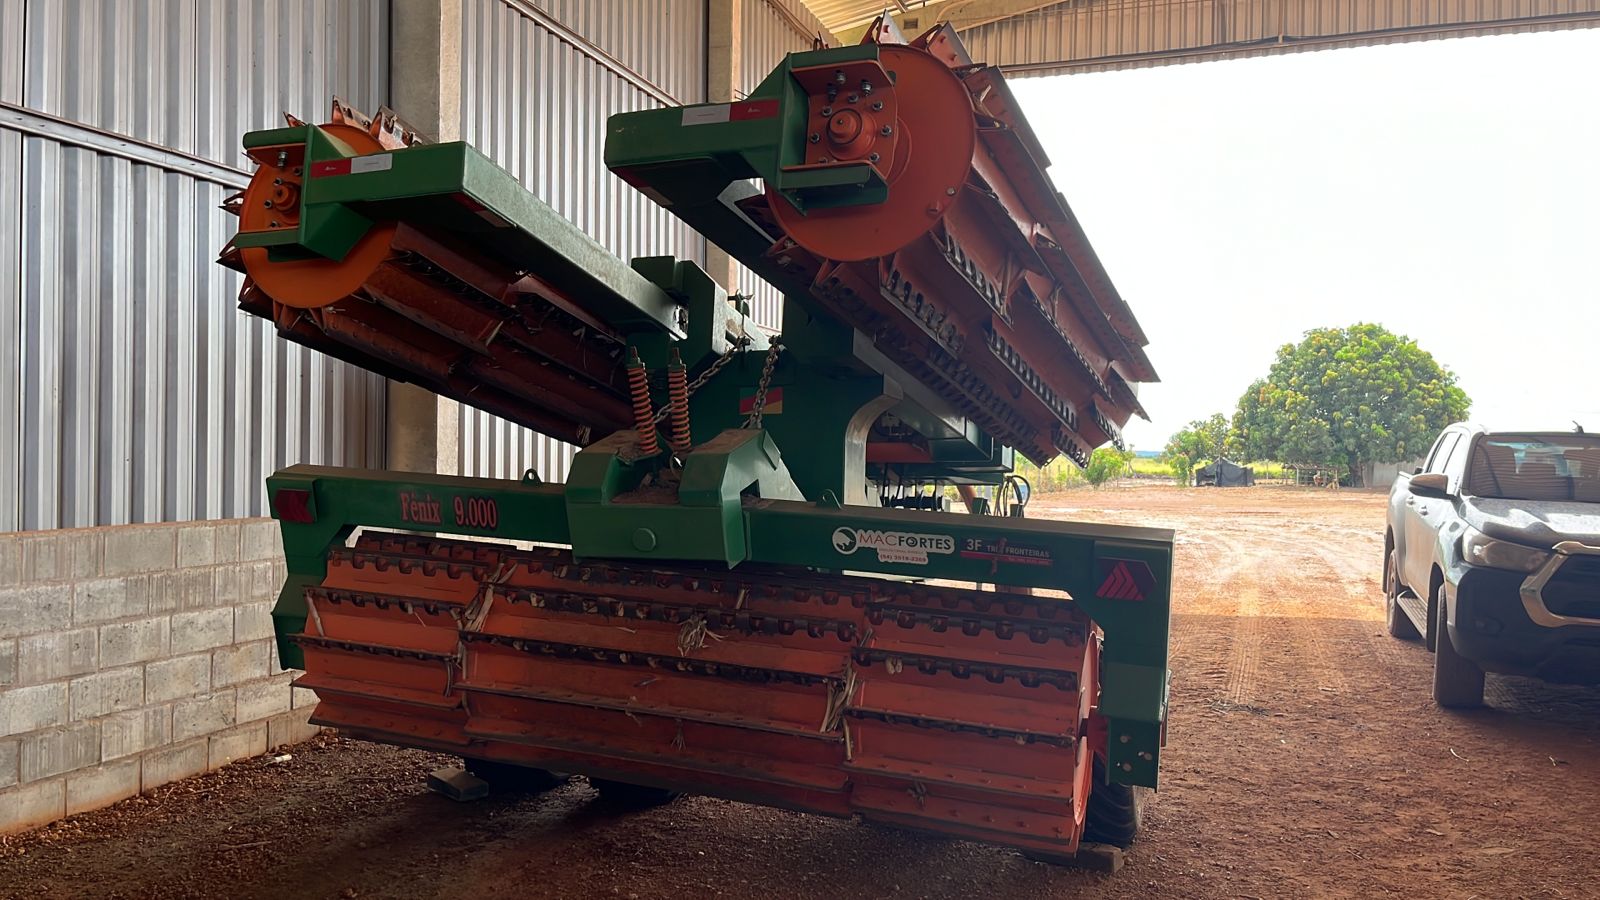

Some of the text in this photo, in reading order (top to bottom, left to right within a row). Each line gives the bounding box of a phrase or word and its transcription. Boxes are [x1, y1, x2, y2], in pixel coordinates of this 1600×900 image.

[454, 496, 498, 528] 9.000
[859, 533, 951, 550] MACFORTES
[967, 538, 982, 551] 3F
[1005, 546, 1050, 558] FRONTEIRAS
